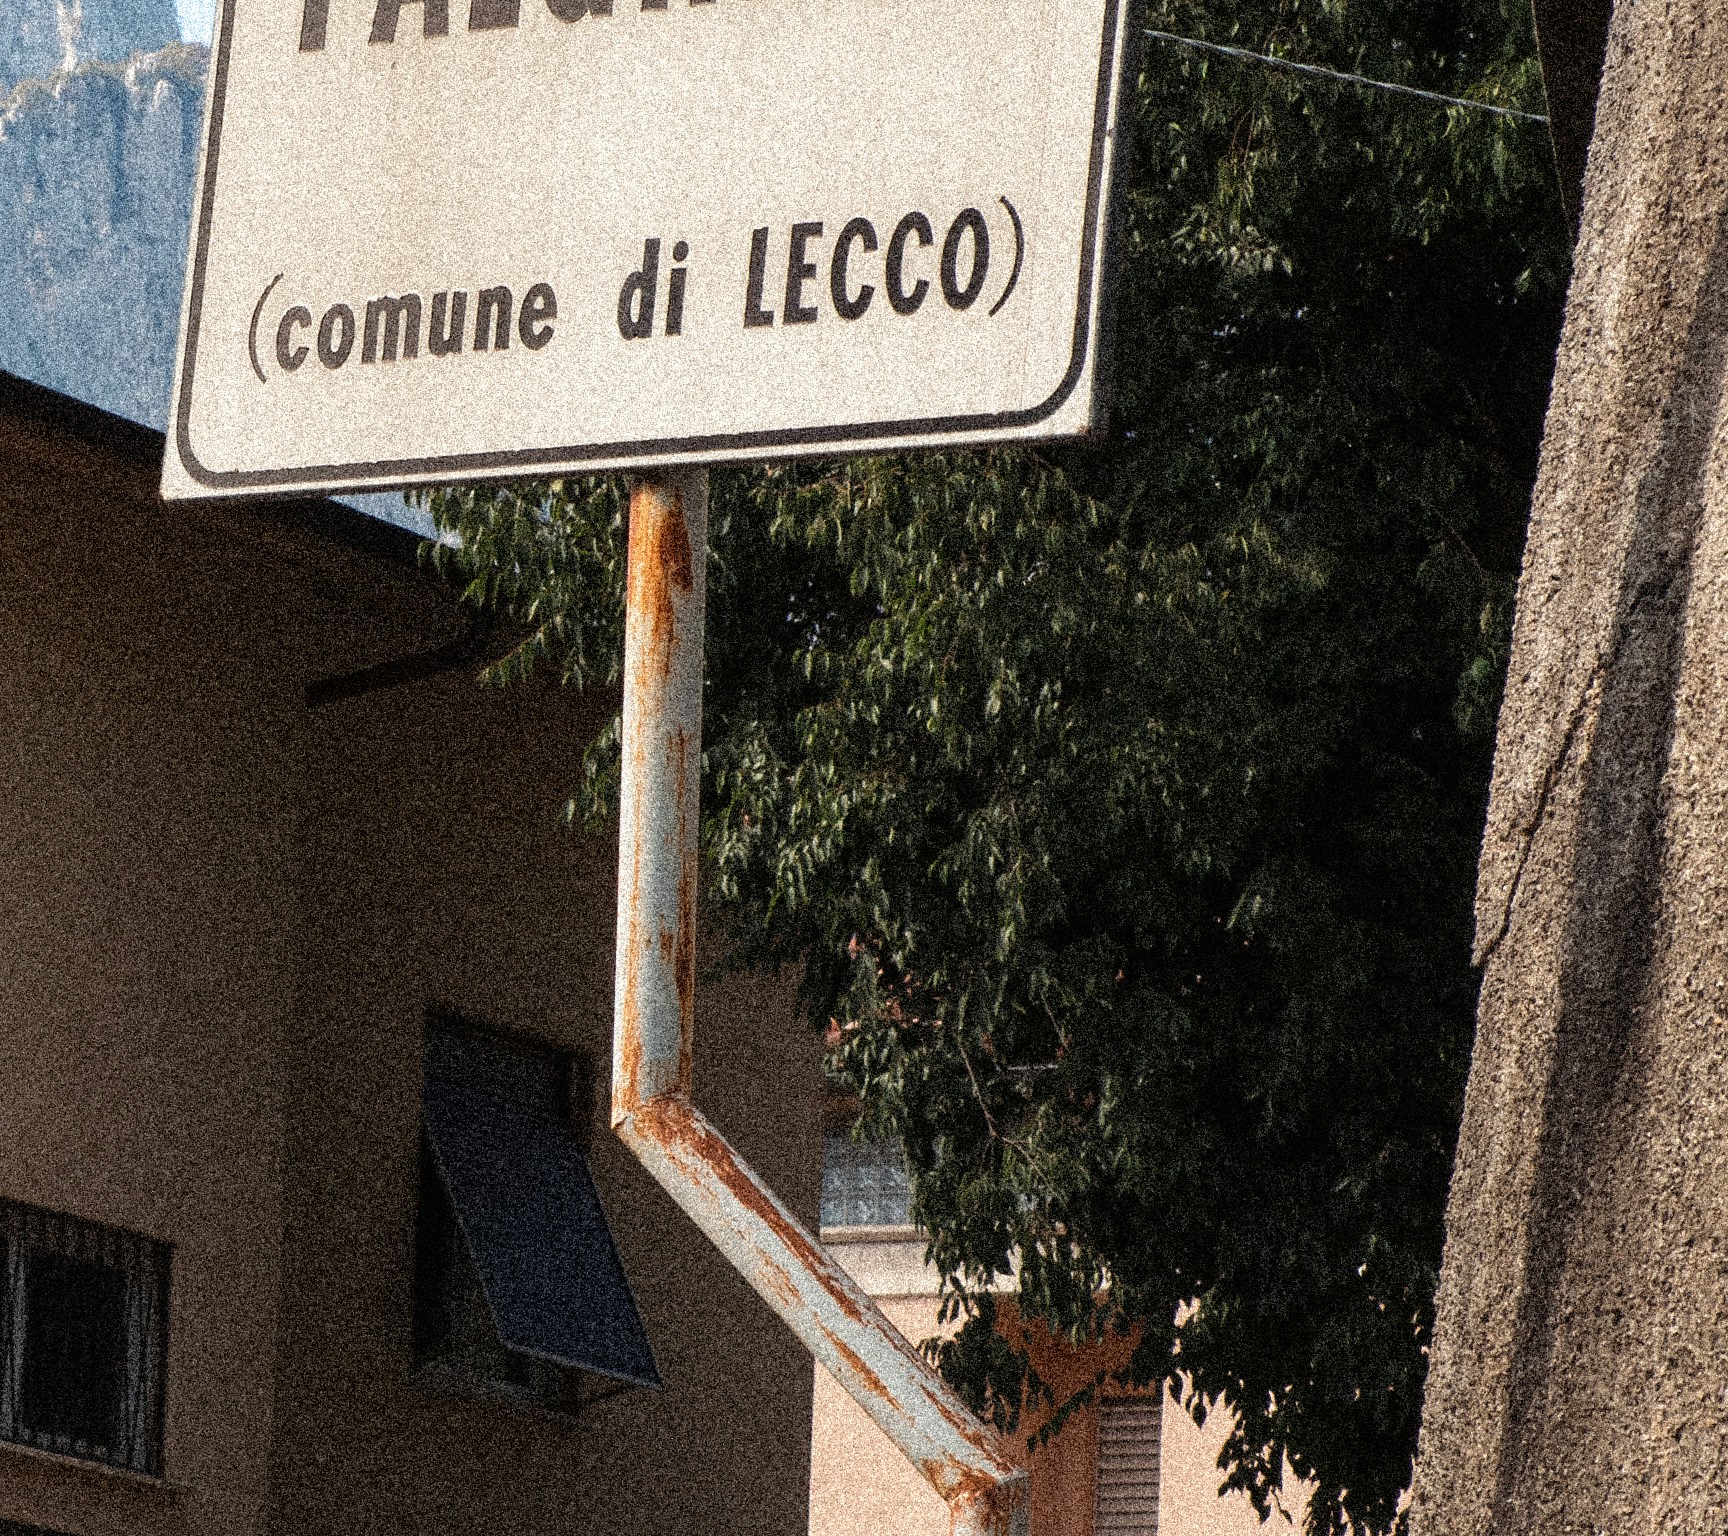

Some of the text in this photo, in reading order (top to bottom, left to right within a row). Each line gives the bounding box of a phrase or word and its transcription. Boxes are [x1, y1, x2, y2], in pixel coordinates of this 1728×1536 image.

[248, 195, 1025, 384] (comune di LECCO)
